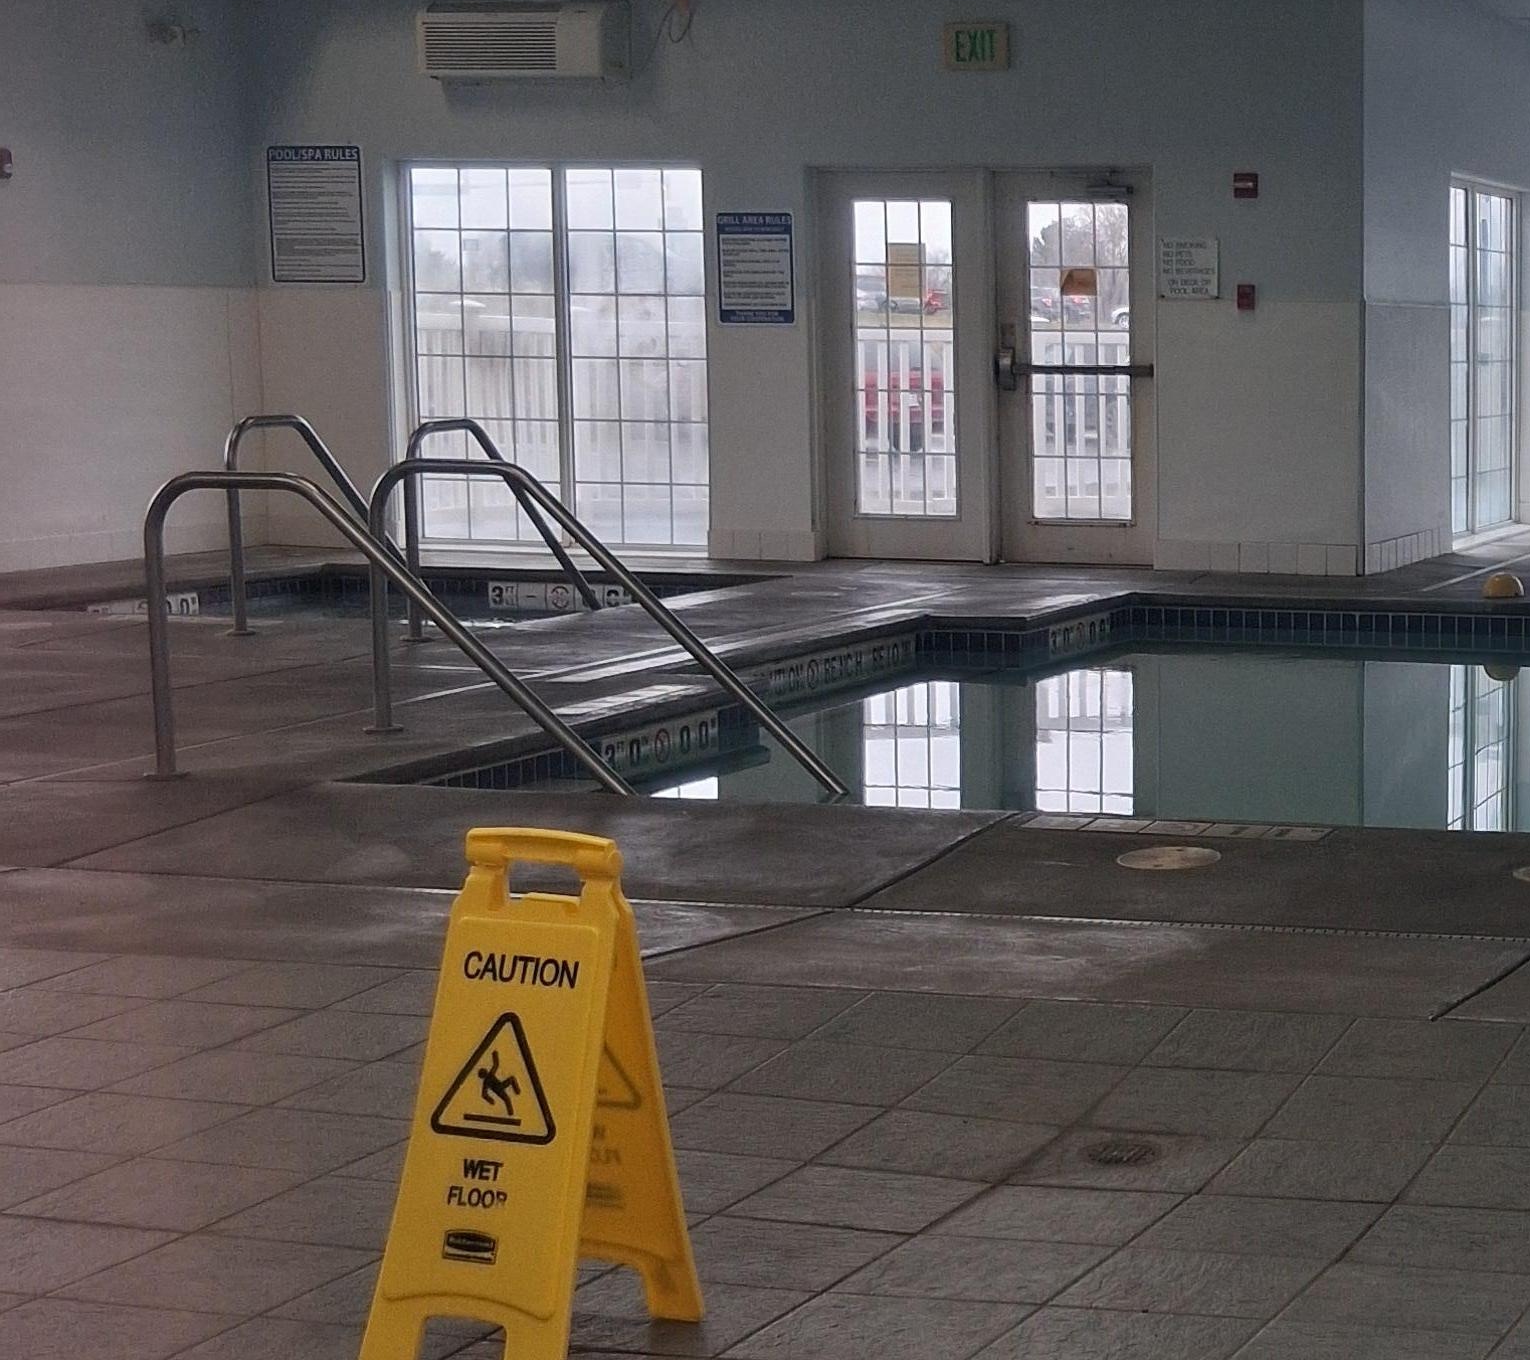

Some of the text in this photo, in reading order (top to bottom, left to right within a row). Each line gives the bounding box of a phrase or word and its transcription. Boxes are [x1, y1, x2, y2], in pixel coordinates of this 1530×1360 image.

[955, 30, 998, 62] EXIT
[324, 148, 358, 160] RULES
[464, 951, 580, 989] CAUTION
[463, 1159, 504, 1181] WET
[447, 1185, 508, 1209] FLOOR
